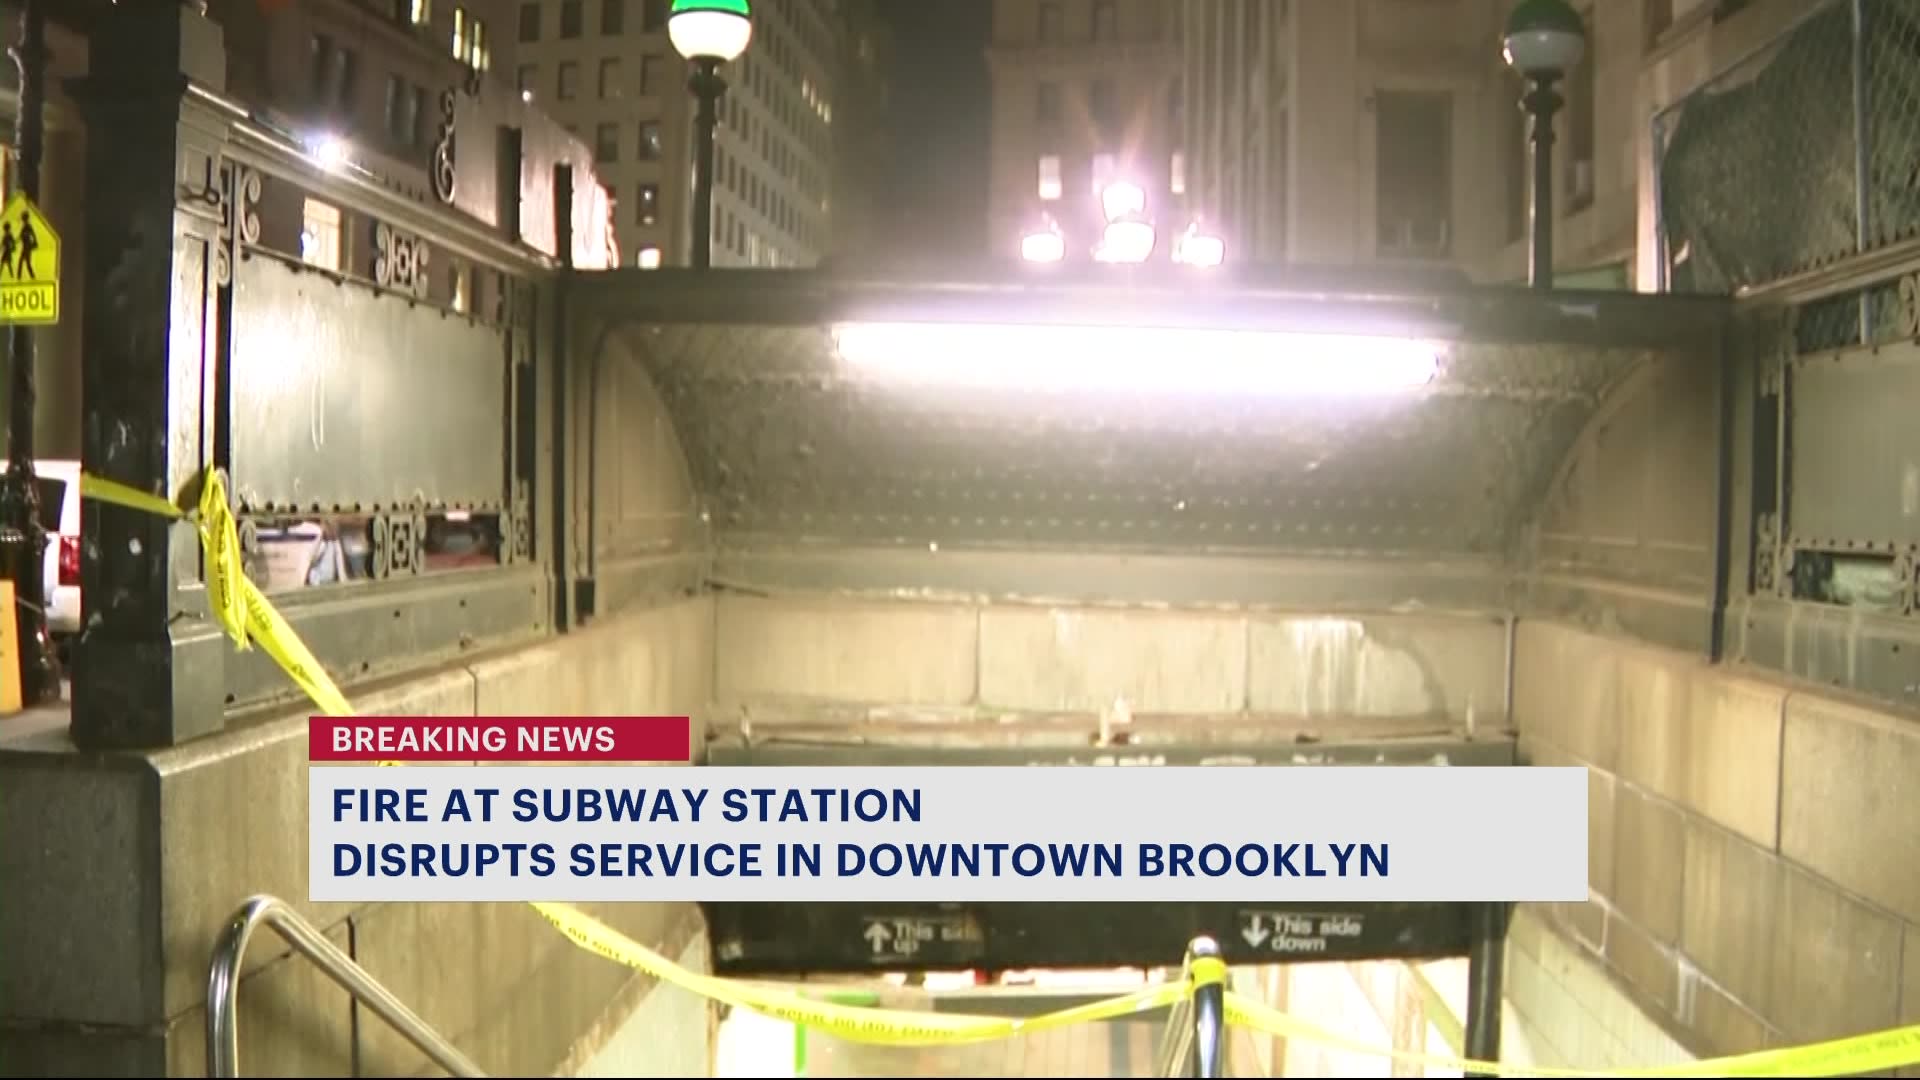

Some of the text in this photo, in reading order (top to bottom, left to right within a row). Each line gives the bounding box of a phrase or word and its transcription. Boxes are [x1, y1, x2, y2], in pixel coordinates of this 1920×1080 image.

[894, 920, 933, 941] This
[1272, 914, 1362, 936] This side
[893, 939, 919, 958] up
[1271, 935, 1327, 952] down
